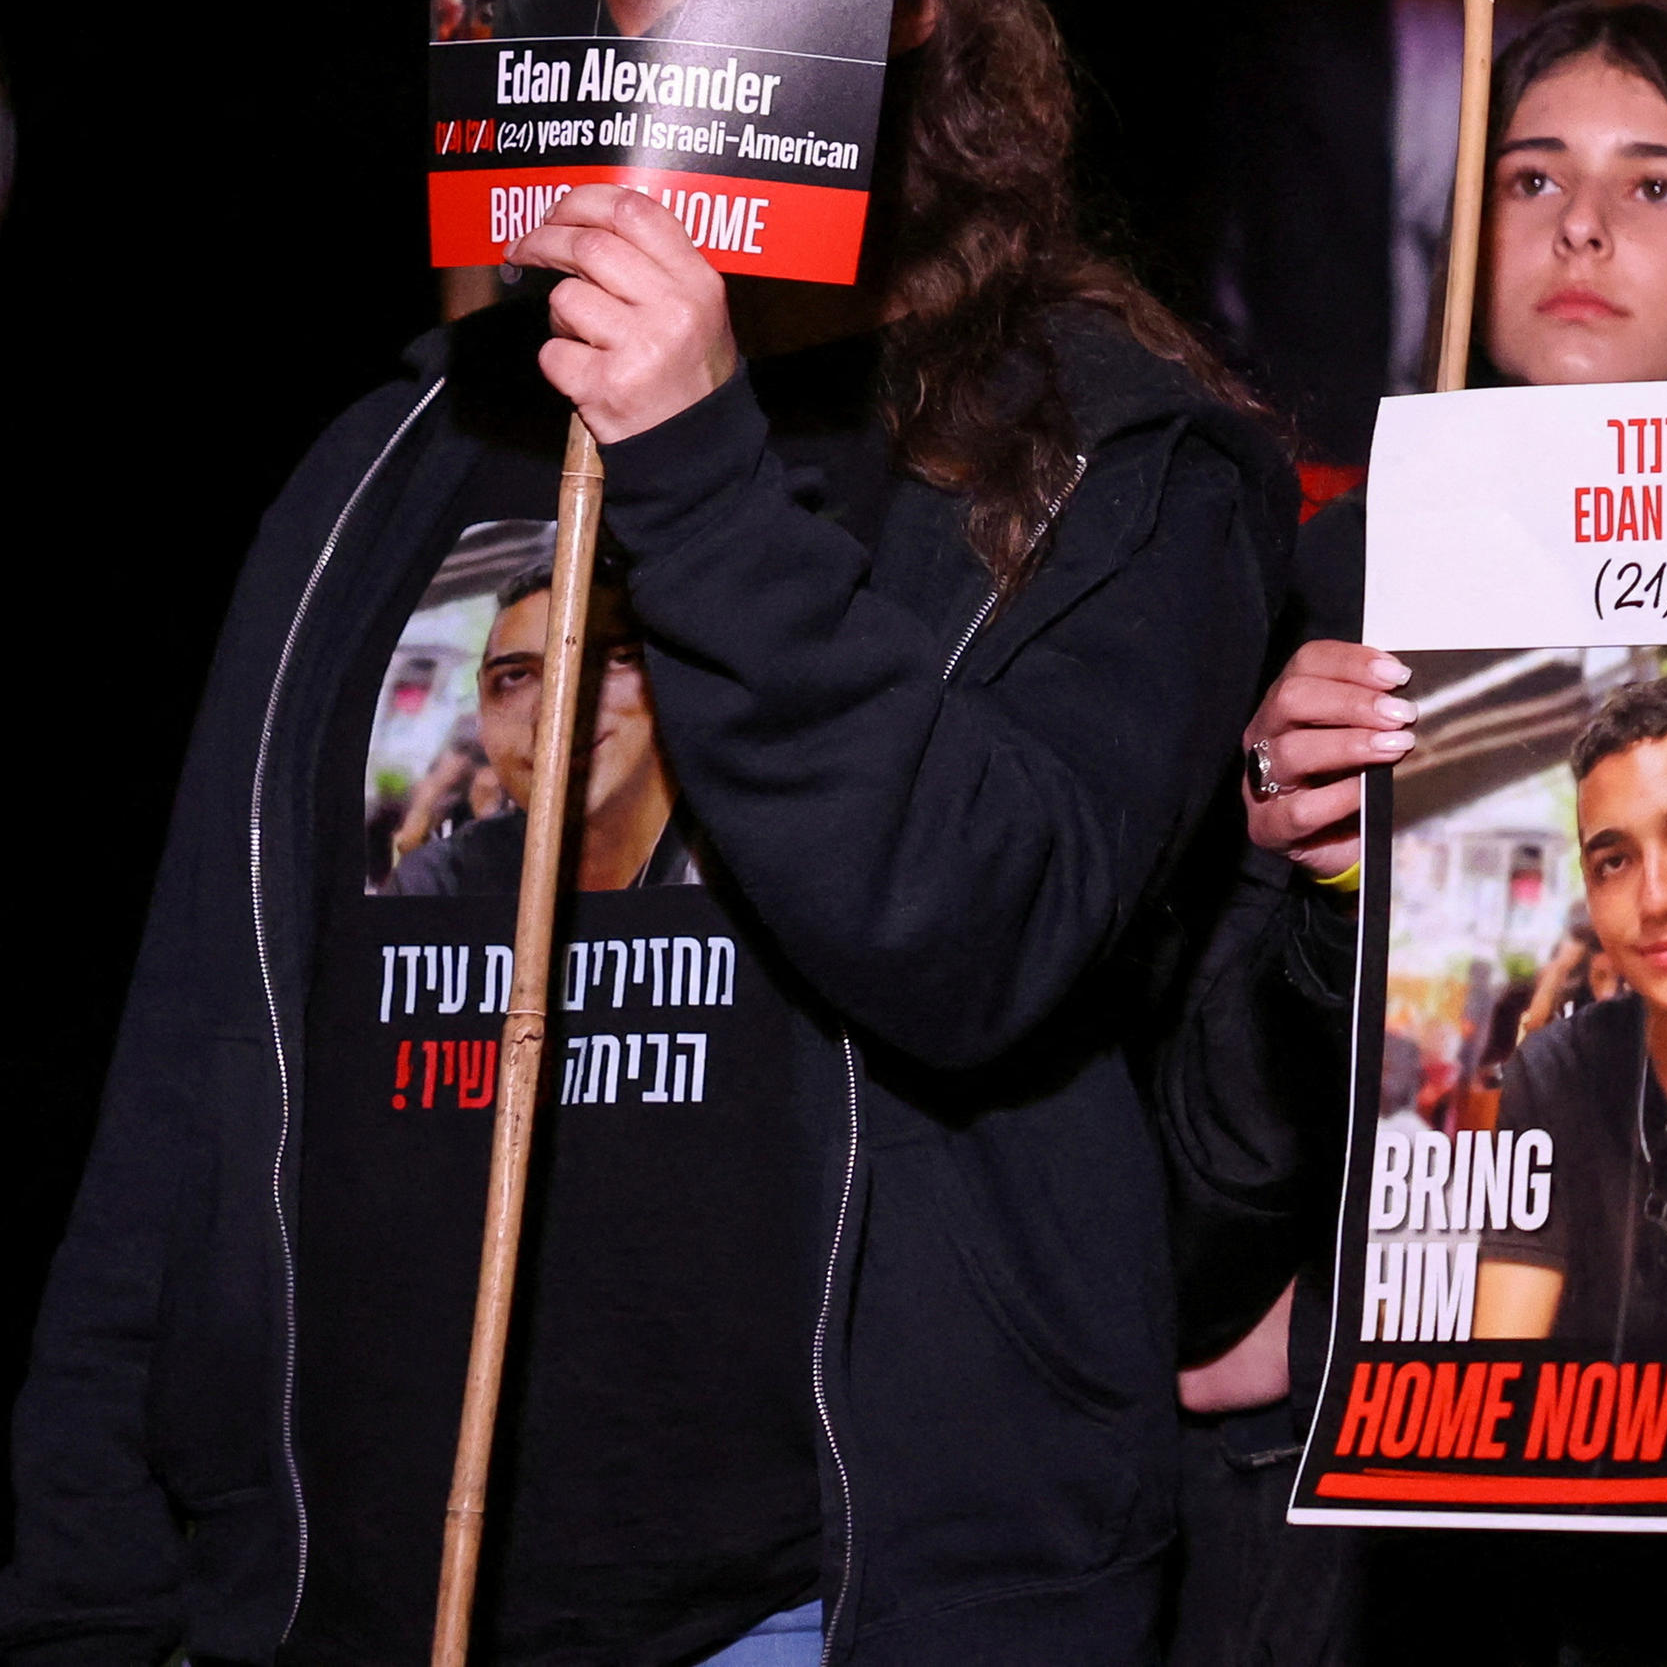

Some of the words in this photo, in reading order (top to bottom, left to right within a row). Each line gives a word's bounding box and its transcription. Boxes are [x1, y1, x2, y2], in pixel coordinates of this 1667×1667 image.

[497, 50, 571, 104] Edan
[576, 47, 781, 116] Alexander
[497, 120, 534, 154] (21)
[537, 118, 594, 154] years
[599, 112, 637, 147] old
[642, 113, 859, 170] Israeli-American
[1574, 484, 1663, 544] EDAN
[380, 944, 470, 1024] עידן
[561, 936, 736, 1012] מחזירים
[390, 1040, 499, 1110] שיו!
[560, 1032, 708, 1106] הביתה
[1367, 1128, 1554, 1232] BRING
[1360, 1241, 1480, 1343] HIM
[1334, 1361, 1523, 1461] HOME
